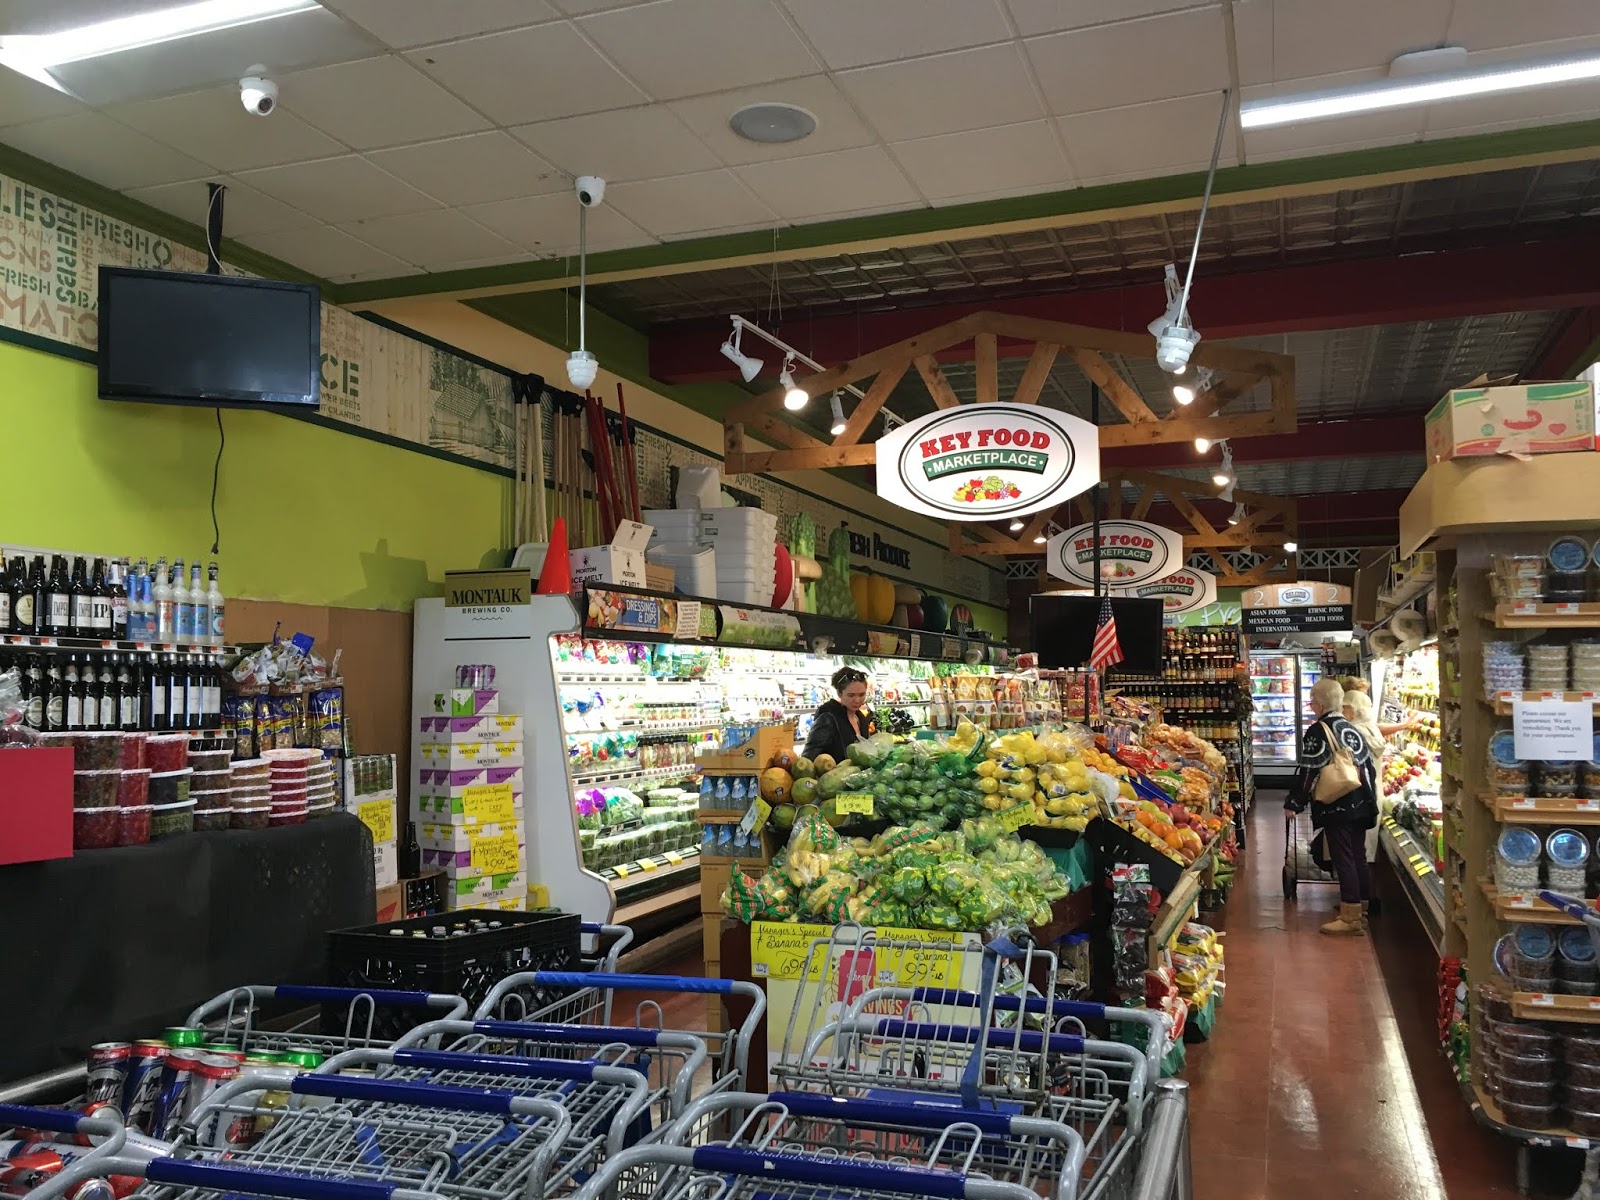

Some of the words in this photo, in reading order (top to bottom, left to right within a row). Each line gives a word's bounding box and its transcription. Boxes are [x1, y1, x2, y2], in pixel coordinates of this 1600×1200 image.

[80, 212, 150, 254] FRESH
[919, 431, 972, 458] KEY
[977, 428, 1051, 450] FOOD
[932, 452, 1038, 473] MARKETPLACE
[1109, 535, 1154, 549] FOOD
[1081, 548, 1146, 560] MAKETPLACE
[575, 567, 597, 575] MORTON
[571, 576, 583, 584] ICE
[584, 574, 603, 582] MELT
[451, 588, 523, 605] MONTAUK
[1141, 586, 1190, 595] MARKETPLACE
[1254, 590, 1265, 606] 2
[1327, 587, 1339, 603] 2
[626, 599, 657, 614] DRESSINGS
[638, 612, 643, 623] &
[644, 613, 657, 624] DIPS
[1255, 625, 1300, 633] INTERNATIONAL
[759, 924, 796, 937] Manager's
[799, 926, 827, 940] Special
[852, 996, 903, 1015] VINGS
